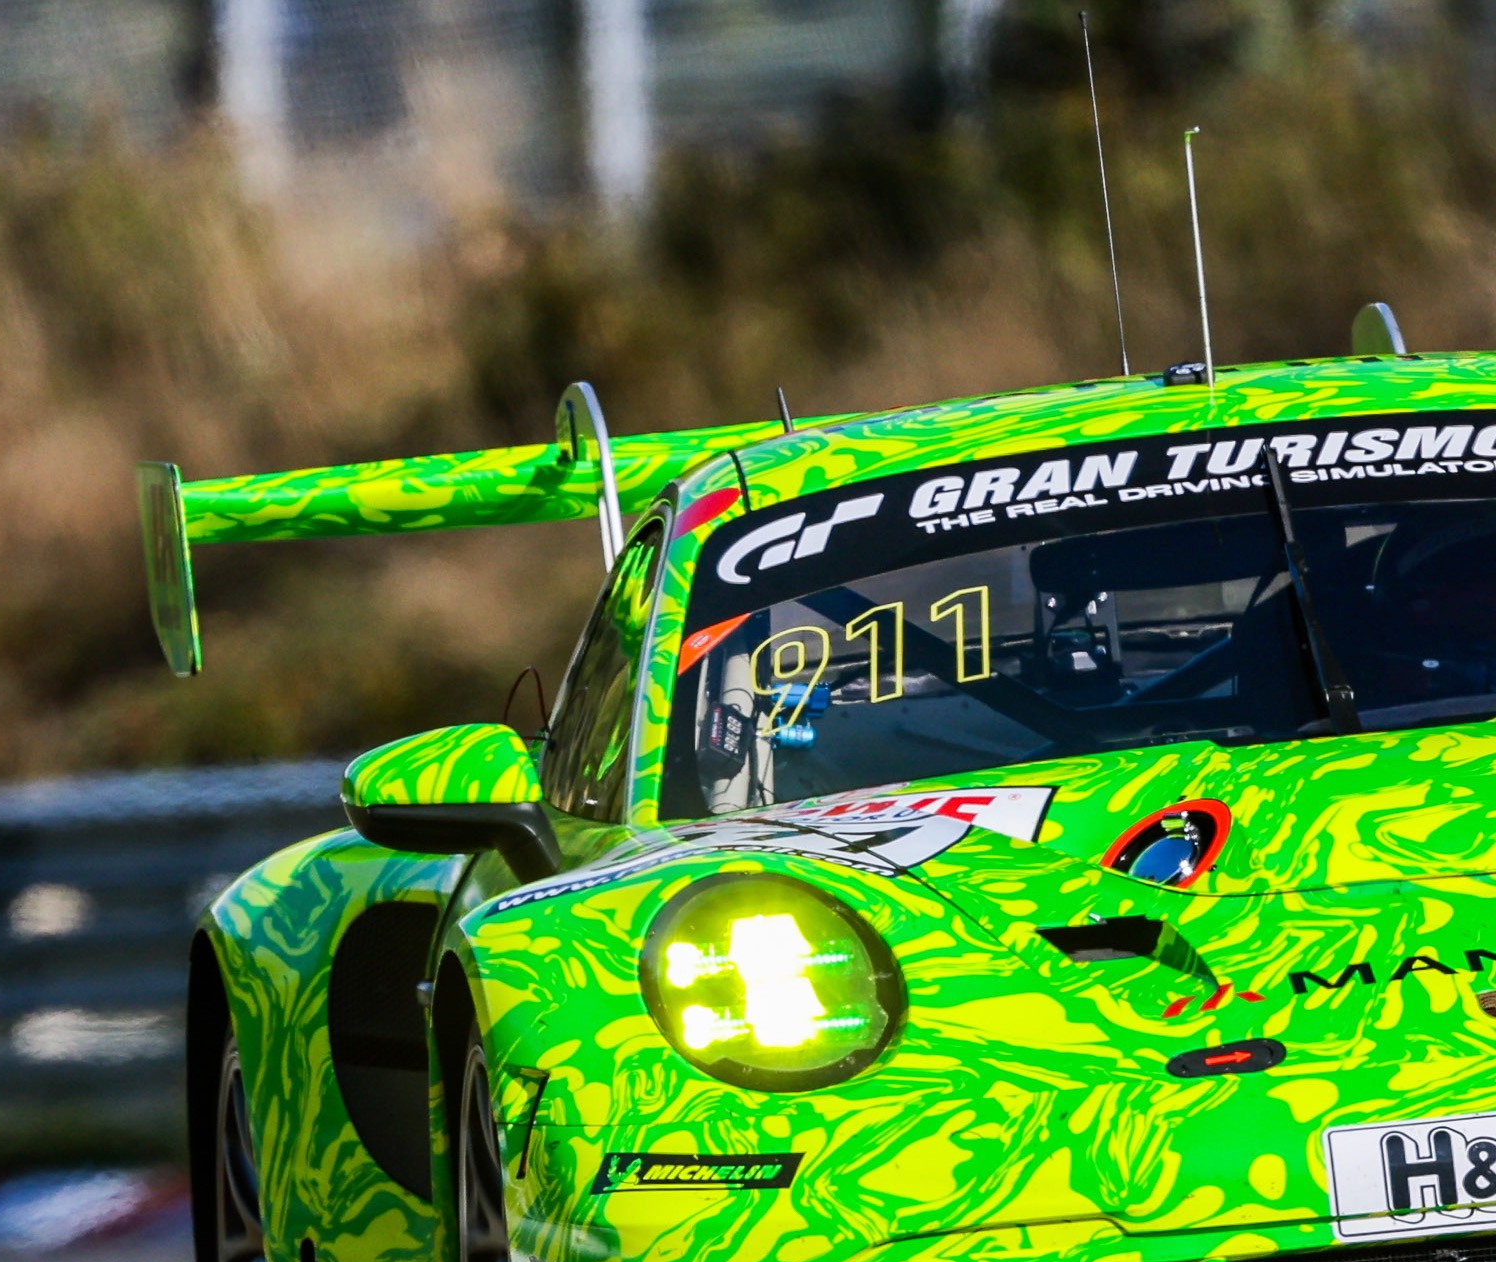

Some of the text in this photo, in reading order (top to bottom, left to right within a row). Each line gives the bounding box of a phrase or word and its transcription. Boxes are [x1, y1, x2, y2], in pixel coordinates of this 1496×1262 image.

[908, 450, 1138, 519] GRAN
[916, 508, 996, 534] THE
[1005, 493, 1109, 519] REAL
[750, 585, 991, 738] 911
[642, 1163, 783, 1182] MICHELIN
